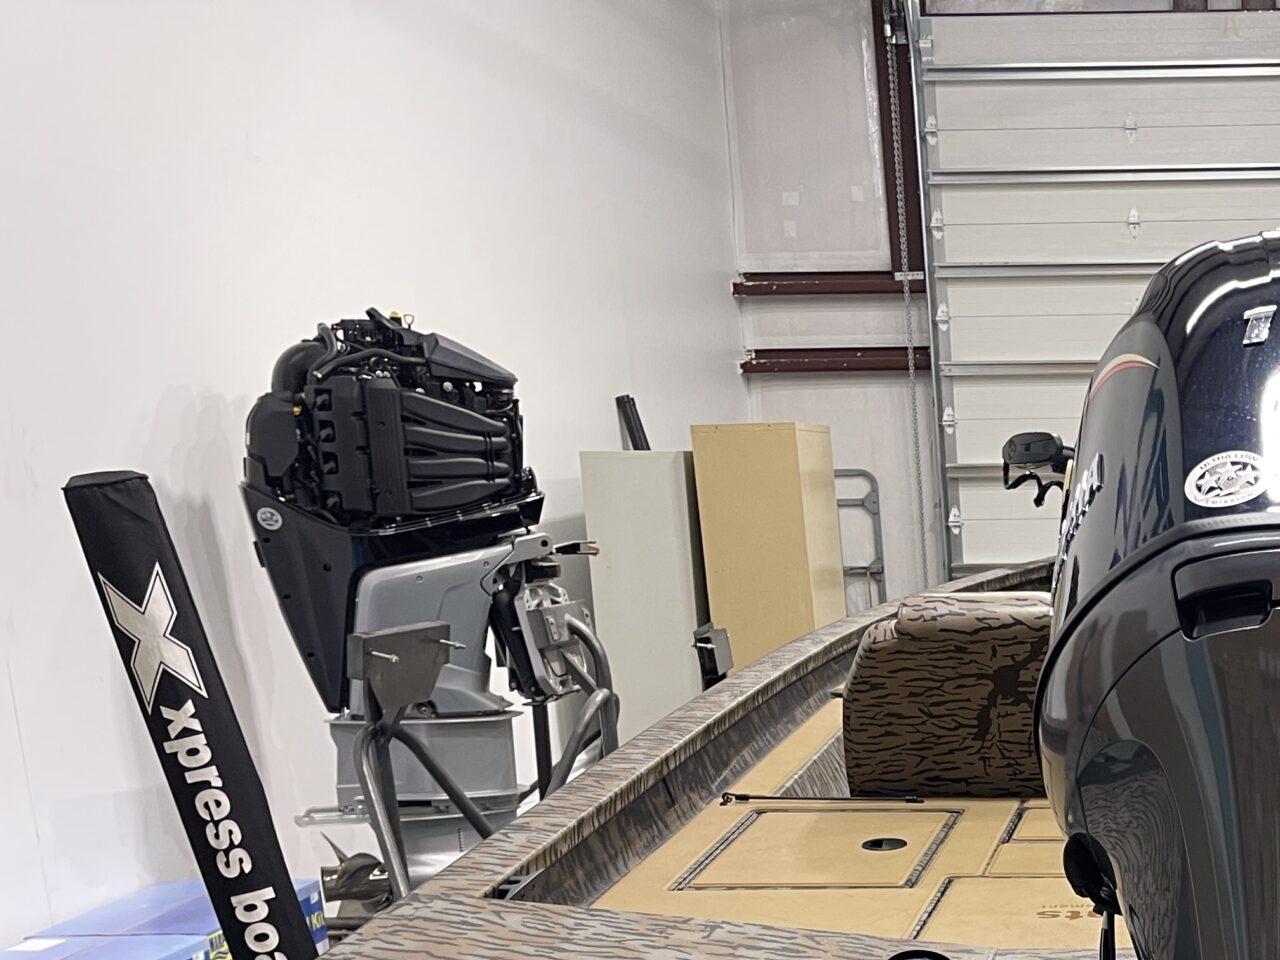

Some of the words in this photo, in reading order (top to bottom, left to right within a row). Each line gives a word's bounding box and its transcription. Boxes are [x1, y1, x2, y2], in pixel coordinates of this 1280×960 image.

[1199, 454, 1232, 470] ULTRA
[1234, 453, 1258, 462] LOW
[159, 697, 253, 881] xpress
